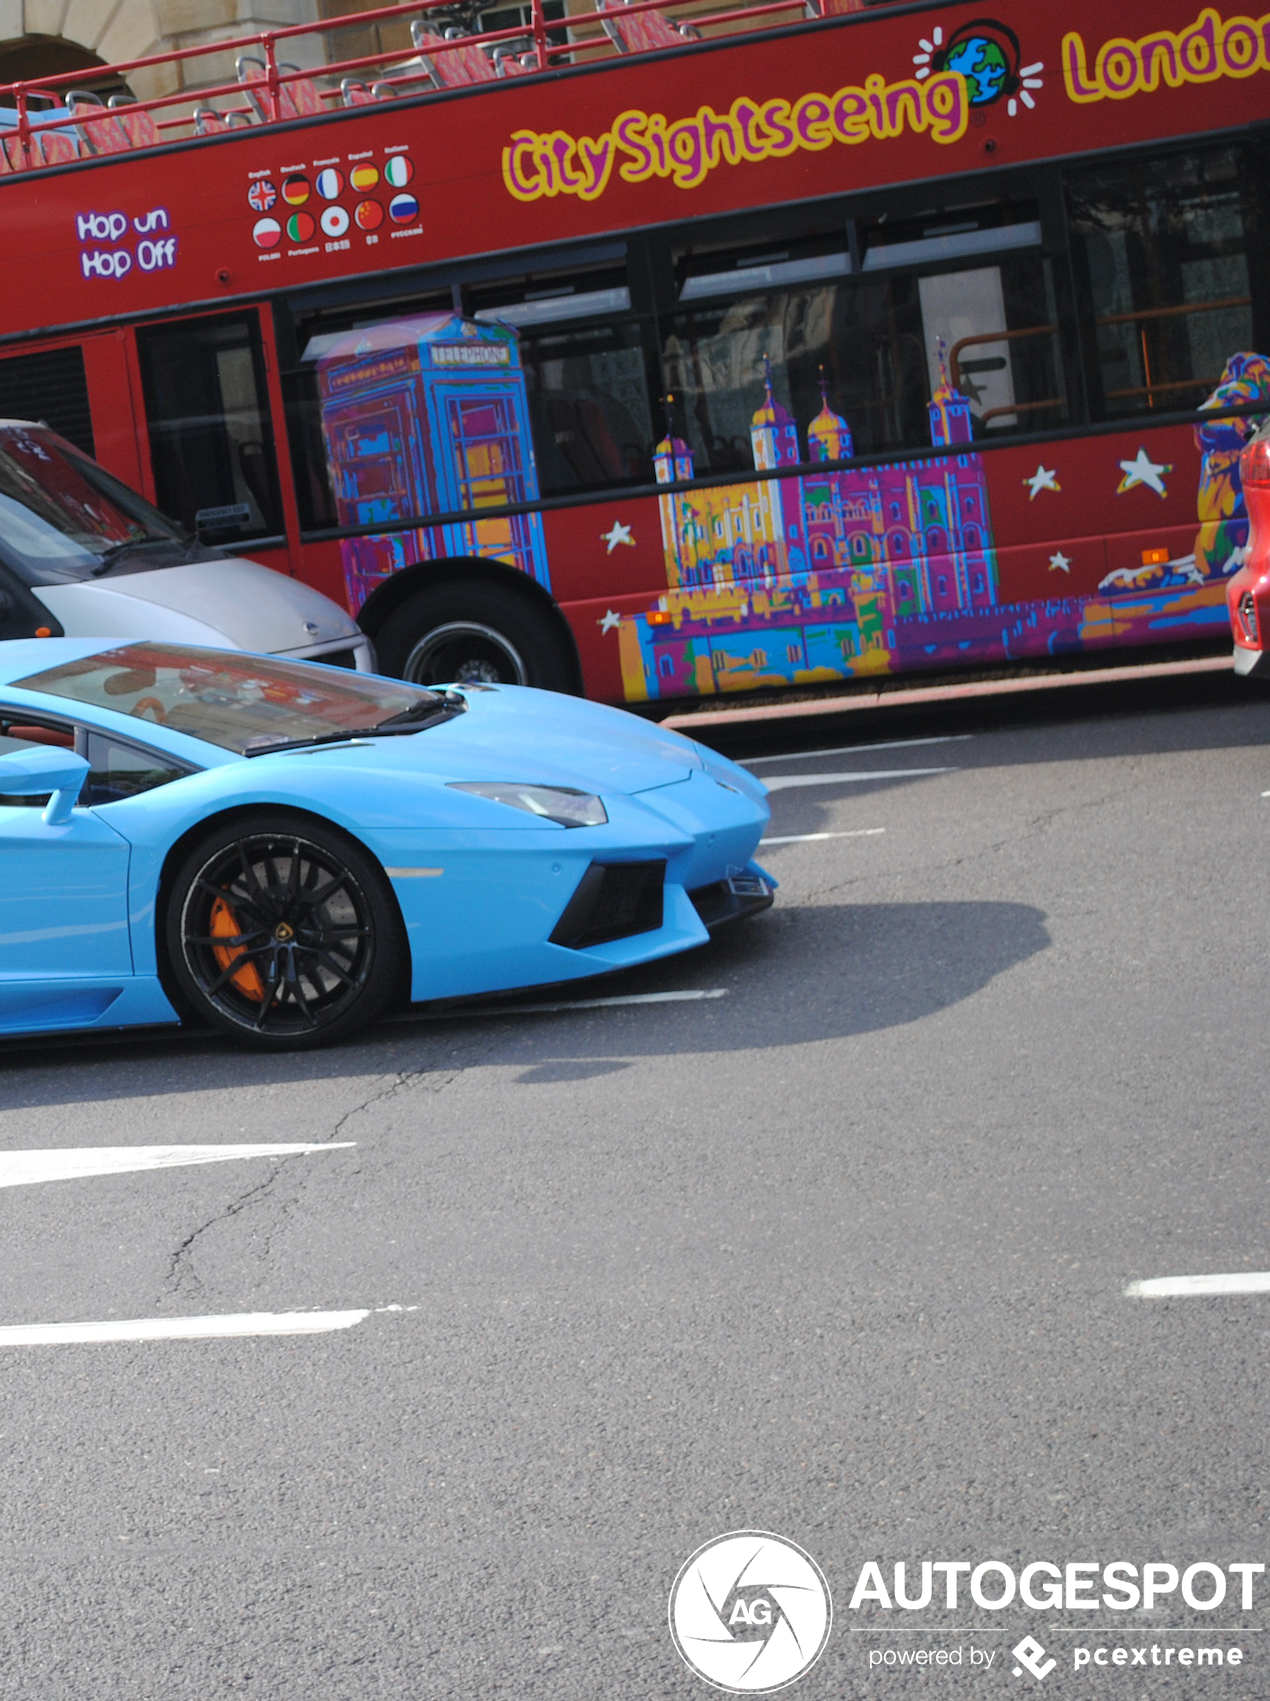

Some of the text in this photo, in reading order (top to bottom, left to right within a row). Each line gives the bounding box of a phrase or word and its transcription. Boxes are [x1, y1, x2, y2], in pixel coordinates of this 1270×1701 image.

[1061, 7, 1270, 104] Londo
[76, 211, 128, 242] Hop
[80, 236, 177, 279] Hop Off
